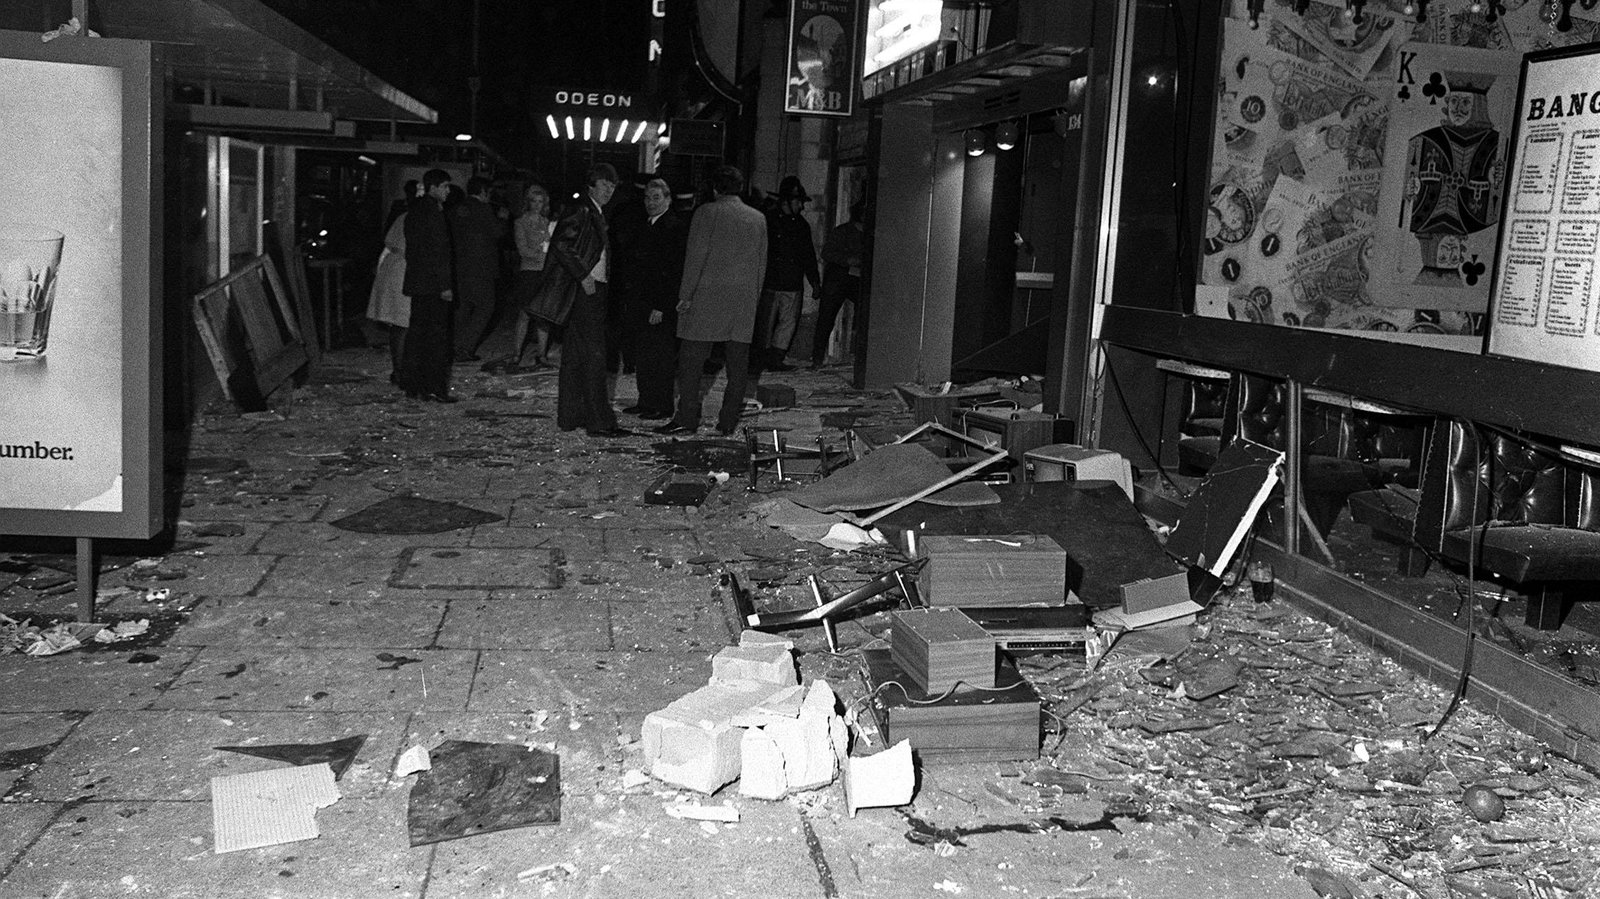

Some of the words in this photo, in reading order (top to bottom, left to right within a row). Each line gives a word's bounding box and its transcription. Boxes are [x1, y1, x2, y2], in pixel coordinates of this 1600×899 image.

[802, 0, 818, 11] the
[819, 1, 847, 13] Town
[1397, 51, 1418, 85] K
[555, 91, 632, 108] ODEON
[796, 88, 842, 111] M&B
[1245, 100, 1262, 115] 10
[1323, 234, 1367, 257] ENGLAND
